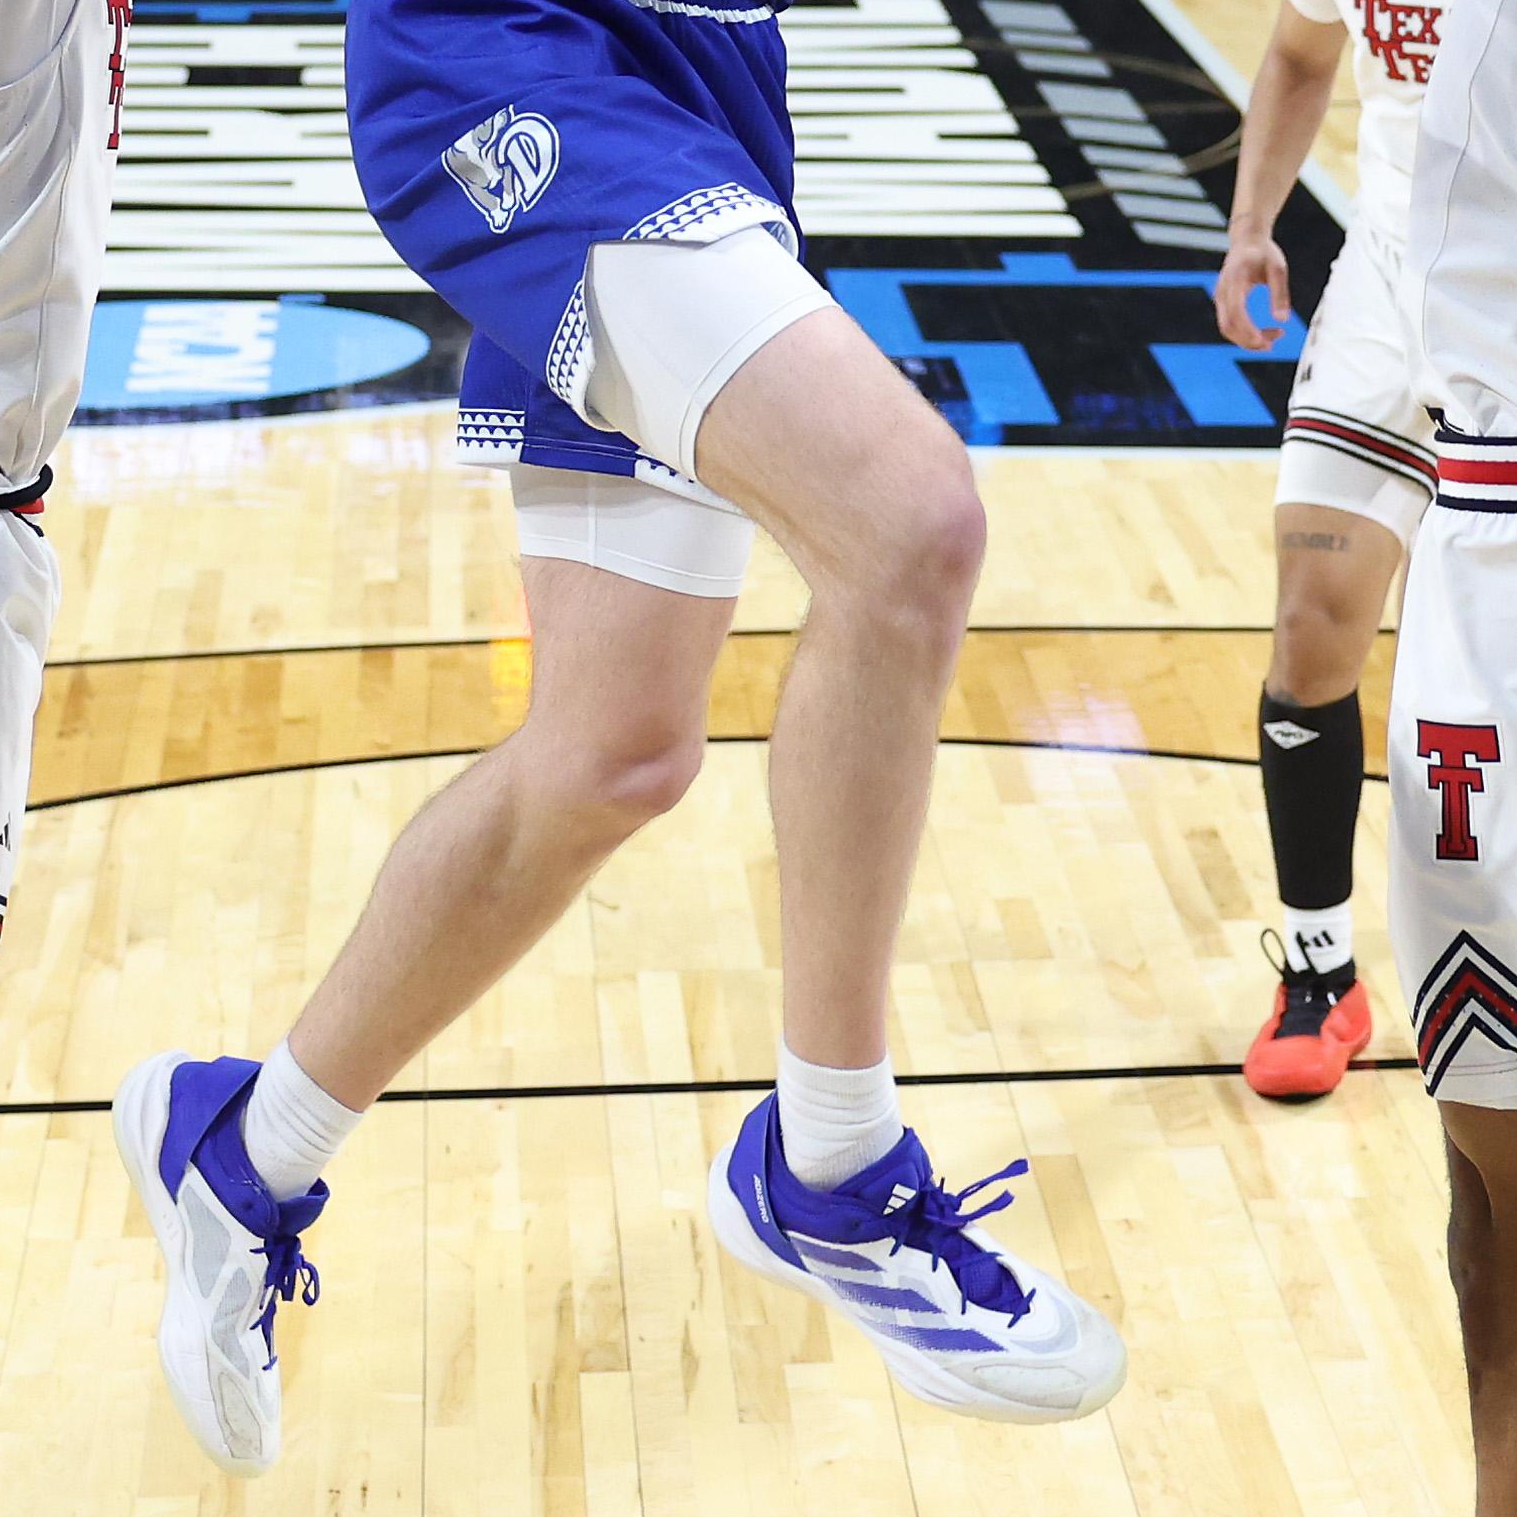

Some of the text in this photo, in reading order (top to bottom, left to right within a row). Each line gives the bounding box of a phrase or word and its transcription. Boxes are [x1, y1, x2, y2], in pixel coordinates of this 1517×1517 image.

[1369, 37, 1435, 84] TE
[124, 301, 281, 393] NCAA
[752, 1173, 770, 1224] ADIZERO
